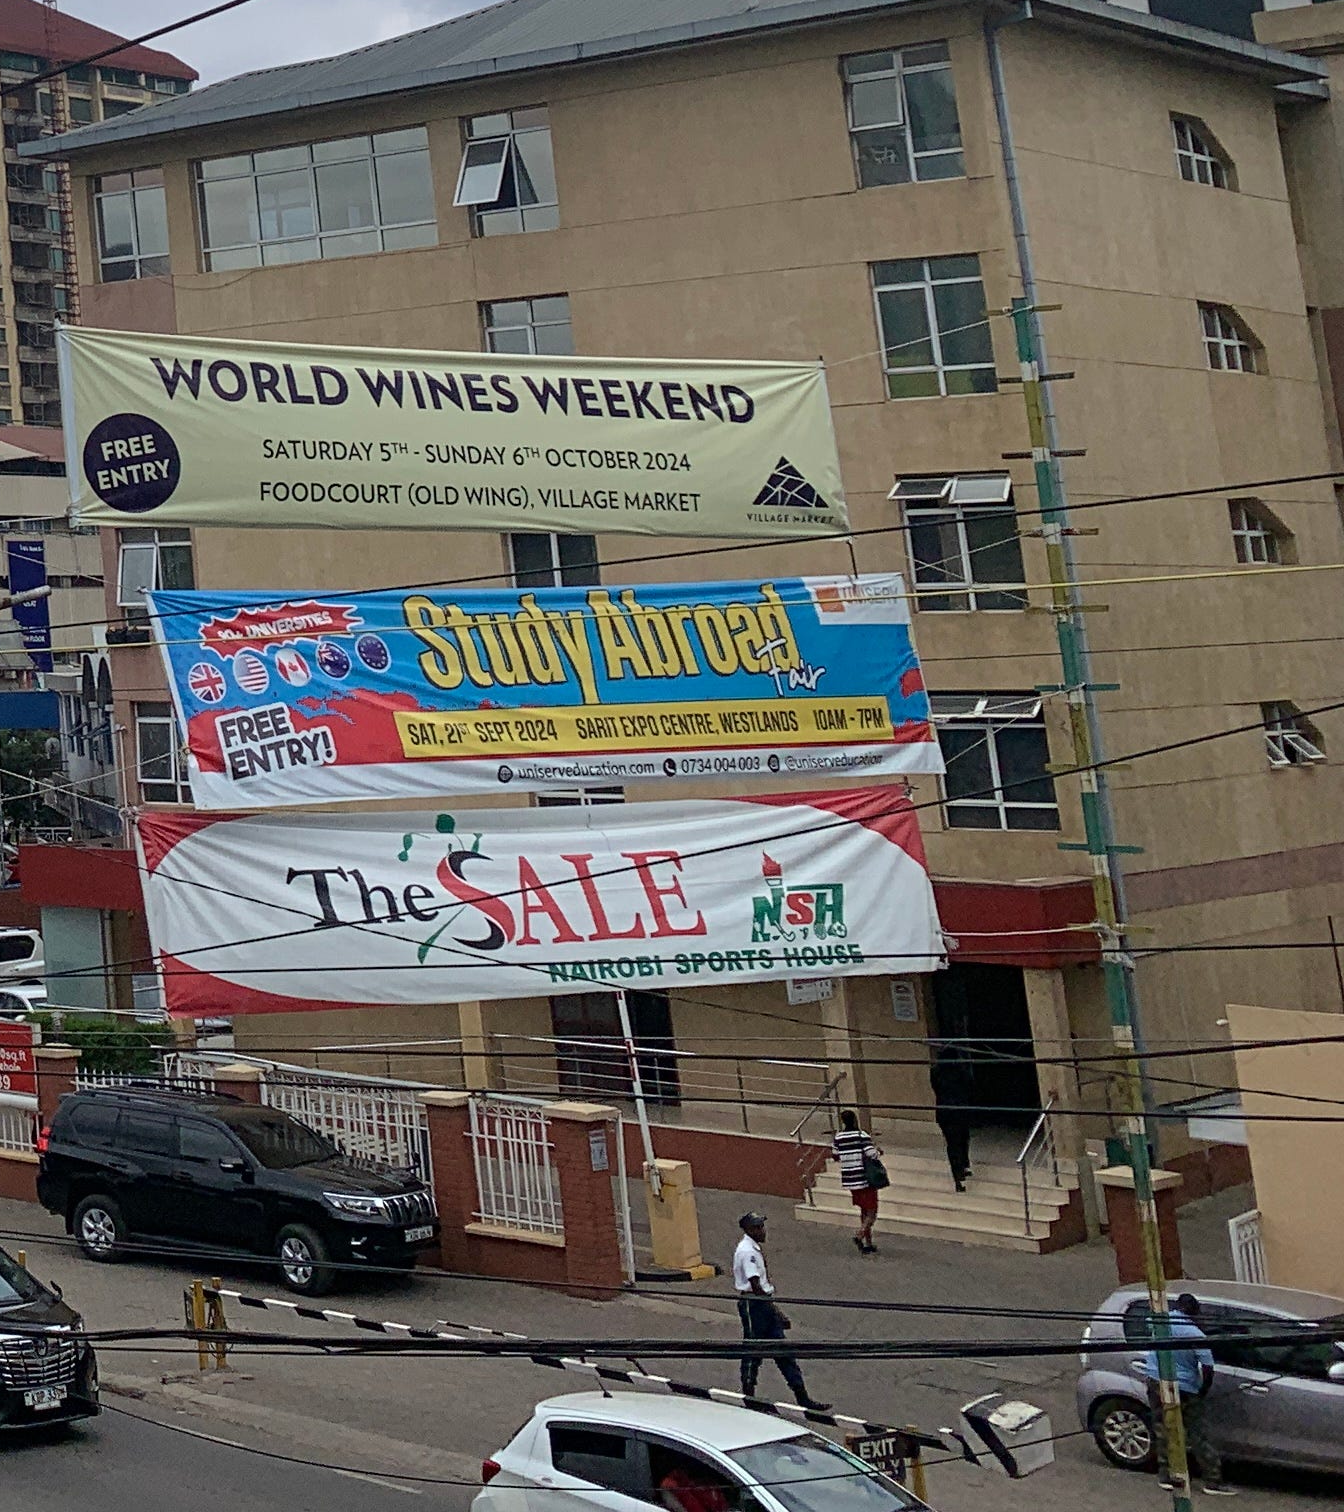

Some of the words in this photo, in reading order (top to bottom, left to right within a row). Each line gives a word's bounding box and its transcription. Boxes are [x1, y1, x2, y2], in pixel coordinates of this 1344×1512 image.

[150, 357, 349, 406] WORLD
[354, 367, 519, 414] WINES
[521, 375, 755, 424] WEEKEND
[100, 433, 157, 462] FREE
[262, 439, 373, 462] SATURDAY
[426, 444, 506, 466] SUNDAY
[545, 448, 642, 471] OCTOBER
[643, 452, 691, 472] 2024
[96, 458, 170, 491] ENTRY
[260, 482, 402, 505] FOODCOURT
[408, 483, 459, 507] (OLD
[464, 486, 535, 511] WING),
[539, 489, 619, 510] VILLAGE
[625, 493, 701, 512] MARKET
[746, 513, 789, 523] VILLAGE
[793, 515, 836, 525] MARKET
[246, 611, 334, 639] UNIVERSITIES
[403, 593, 600, 706] Study
[586, 583, 802, 679] Abroad
[756, 636, 826, 697] Fair
[219, 706, 290, 748] FREE
[407, 722, 444, 746] SAT,
[474, 721, 513, 743] SEPT
[515, 718, 558, 742] 2024
[576, 717, 619, 739] SARIT
[623, 714, 660, 737] EXPO
[662, 712, 719, 737] CENTRE,
[720, 710, 799, 734] WESTLANDS
[812, 708, 849, 731] 10AM
[856, 707, 885, 730] 7PM
[227, 730, 334, 782] ENTRY!
[518, 760, 655, 781] uniserveducation.com
[681, 757, 712, 773] 0734
[714, 757, 737, 773] 004
[738, 756, 760, 772] 003
[286, 864, 440, 927] The
[436, 850, 708, 950] SALE
[751, 881, 848, 943] NSH
[548, 954, 665, 983] NAIROBI
[676, 947, 774, 972] SPORTS
[784, 942, 864, 966] HOUSE
[859, 1438, 896, 1460] EXIT
